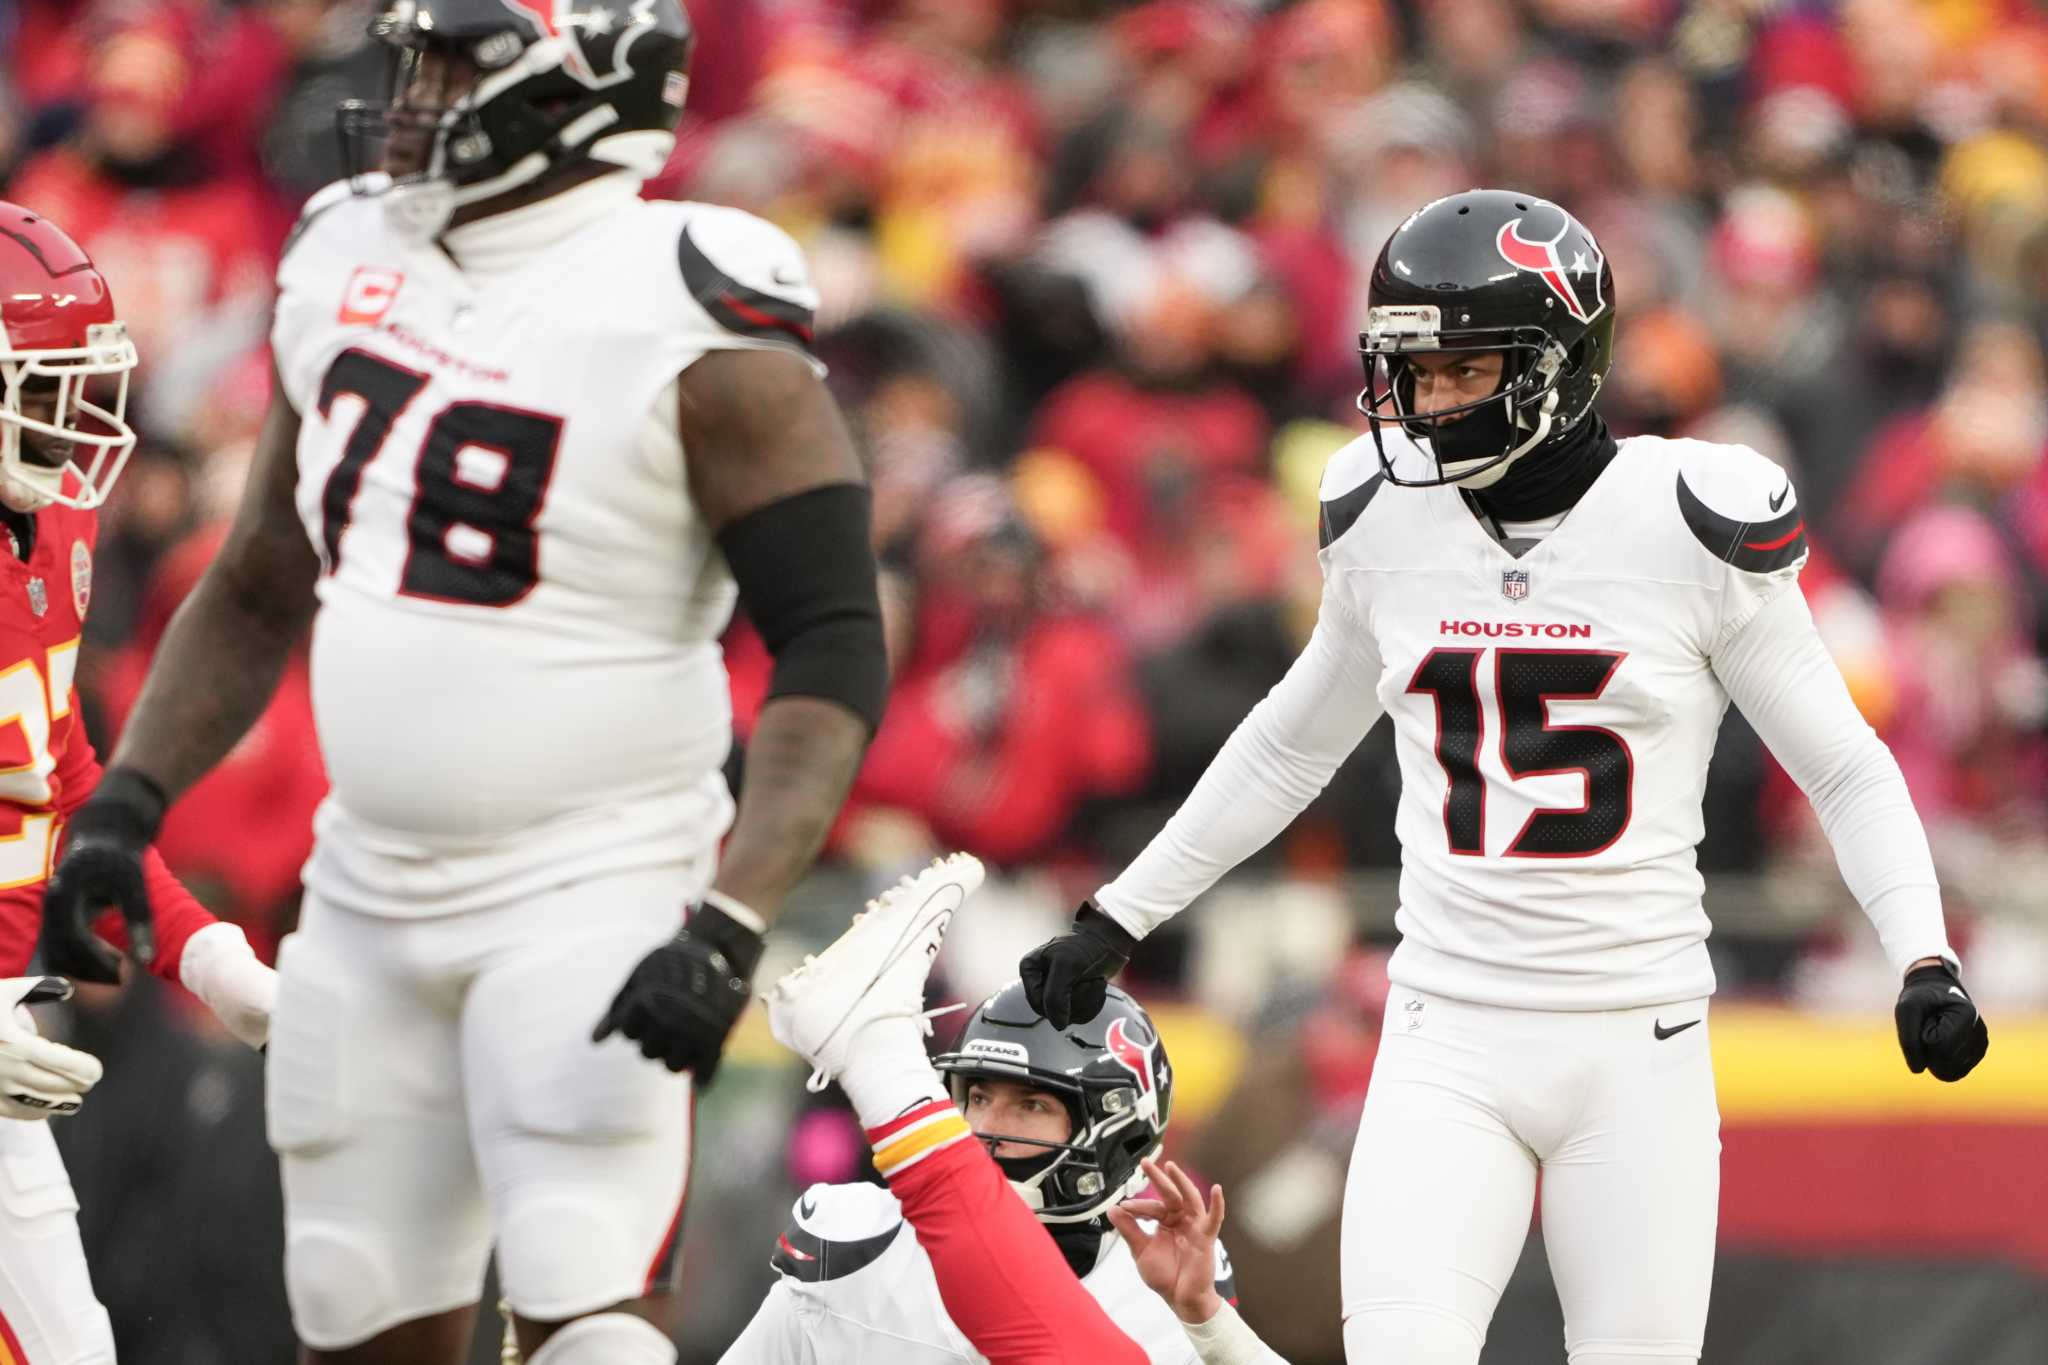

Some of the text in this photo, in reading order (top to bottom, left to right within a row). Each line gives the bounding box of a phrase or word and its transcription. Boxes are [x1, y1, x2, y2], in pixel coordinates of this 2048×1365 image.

[317, 346, 566, 608] 78
[1504, 582, 1525, 597] NFL
[1440, 620, 1592, 639] HOUSTON
[1405, 647, 1634, 859] 15
[969, 1044, 1020, 1057] TEXANS
